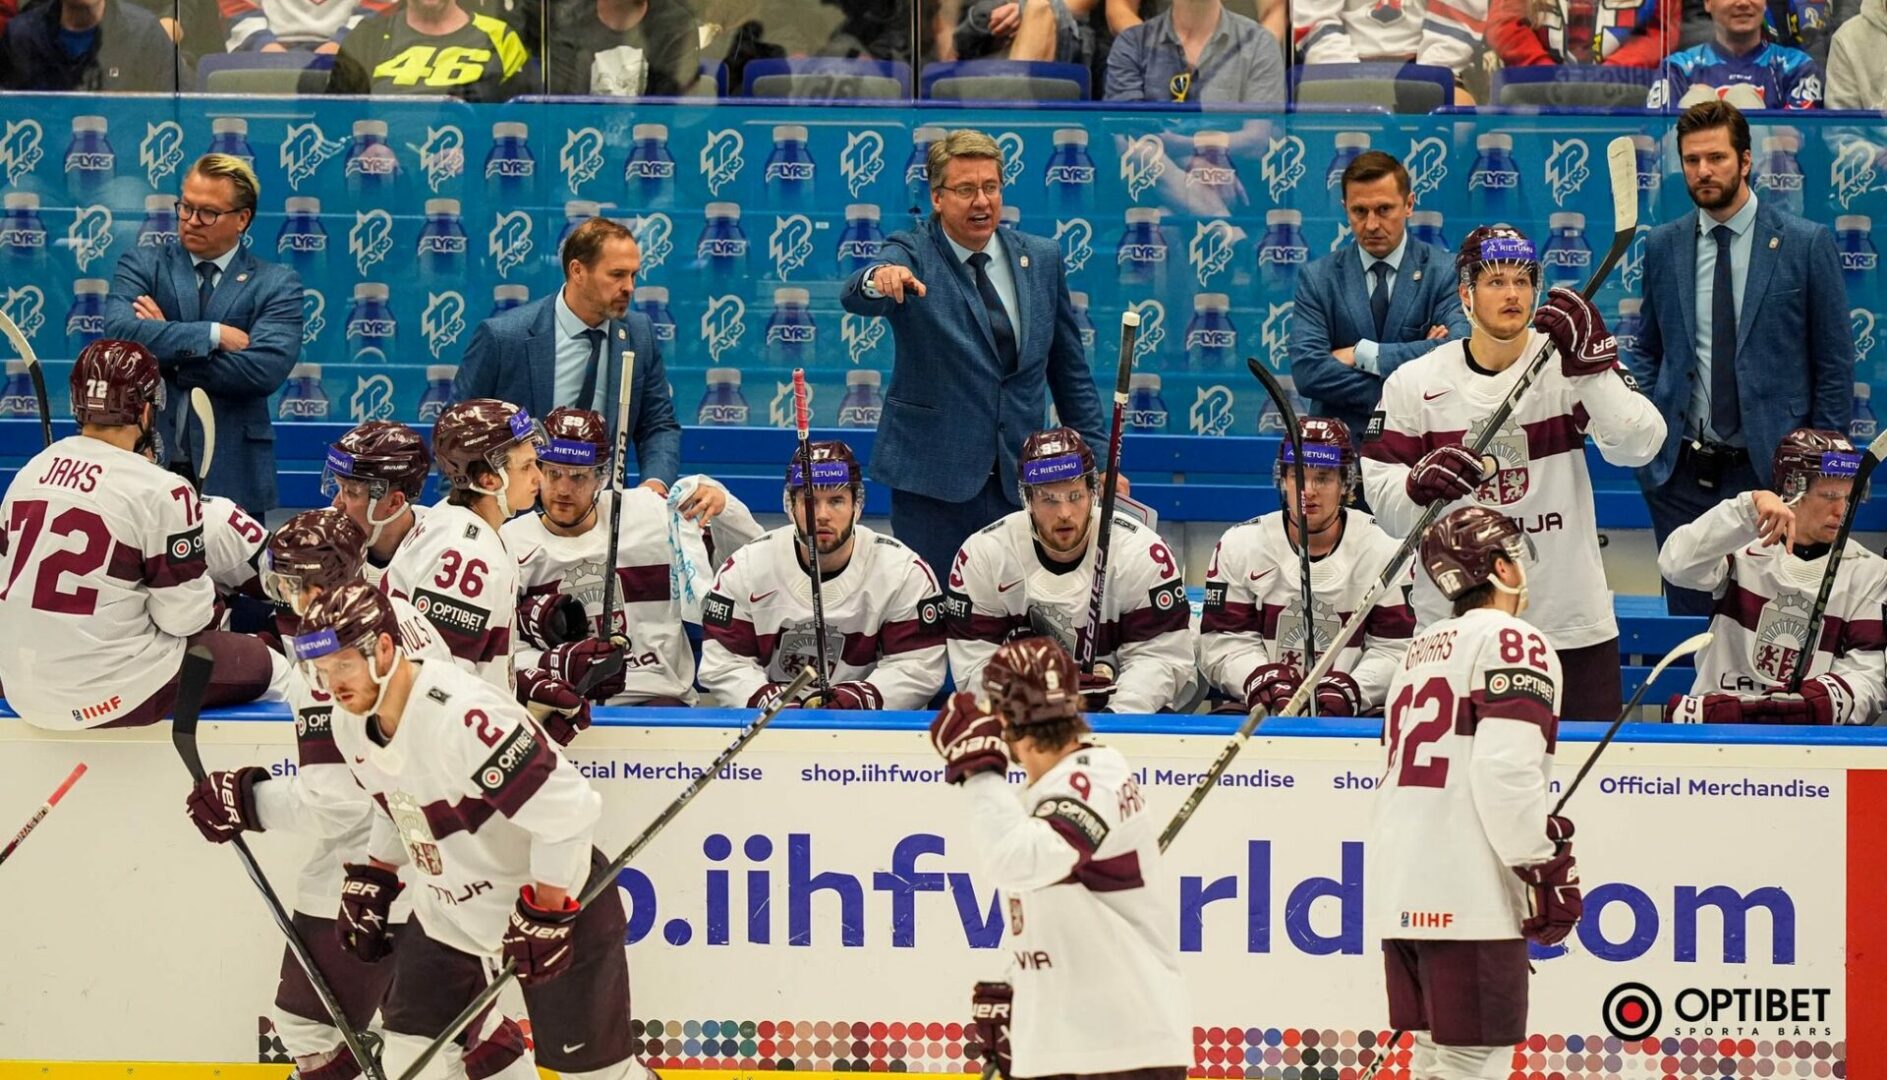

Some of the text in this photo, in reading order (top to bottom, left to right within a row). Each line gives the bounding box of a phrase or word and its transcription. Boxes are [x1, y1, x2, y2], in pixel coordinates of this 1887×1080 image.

[373, 46, 491, 86] 46
[1840, 252, 1877, 270] LYRS
[67, 315, 104, 335] FLYR
[86, 380, 108, 399] 72
[554, 446, 591, 457] RIETUMU
[39, 457, 103, 493] JAKS
[1040, 462, 1077, 474] RIETUMU
[0, 500, 112, 615] 72
[434, 549, 489, 598] 36
[432, 601, 484, 628] OPTIBET
[1499, 628, 1549, 672] 82
[82, 695, 122, 719] IIHF
[464, 709, 505, 749] 2
[1069, 771, 1091, 801] 9
[1600, 776, 1830, 798] Official Merchandise
[510, 911, 570, 939] AUER
[1412, 912, 1453, 928] IIHF
